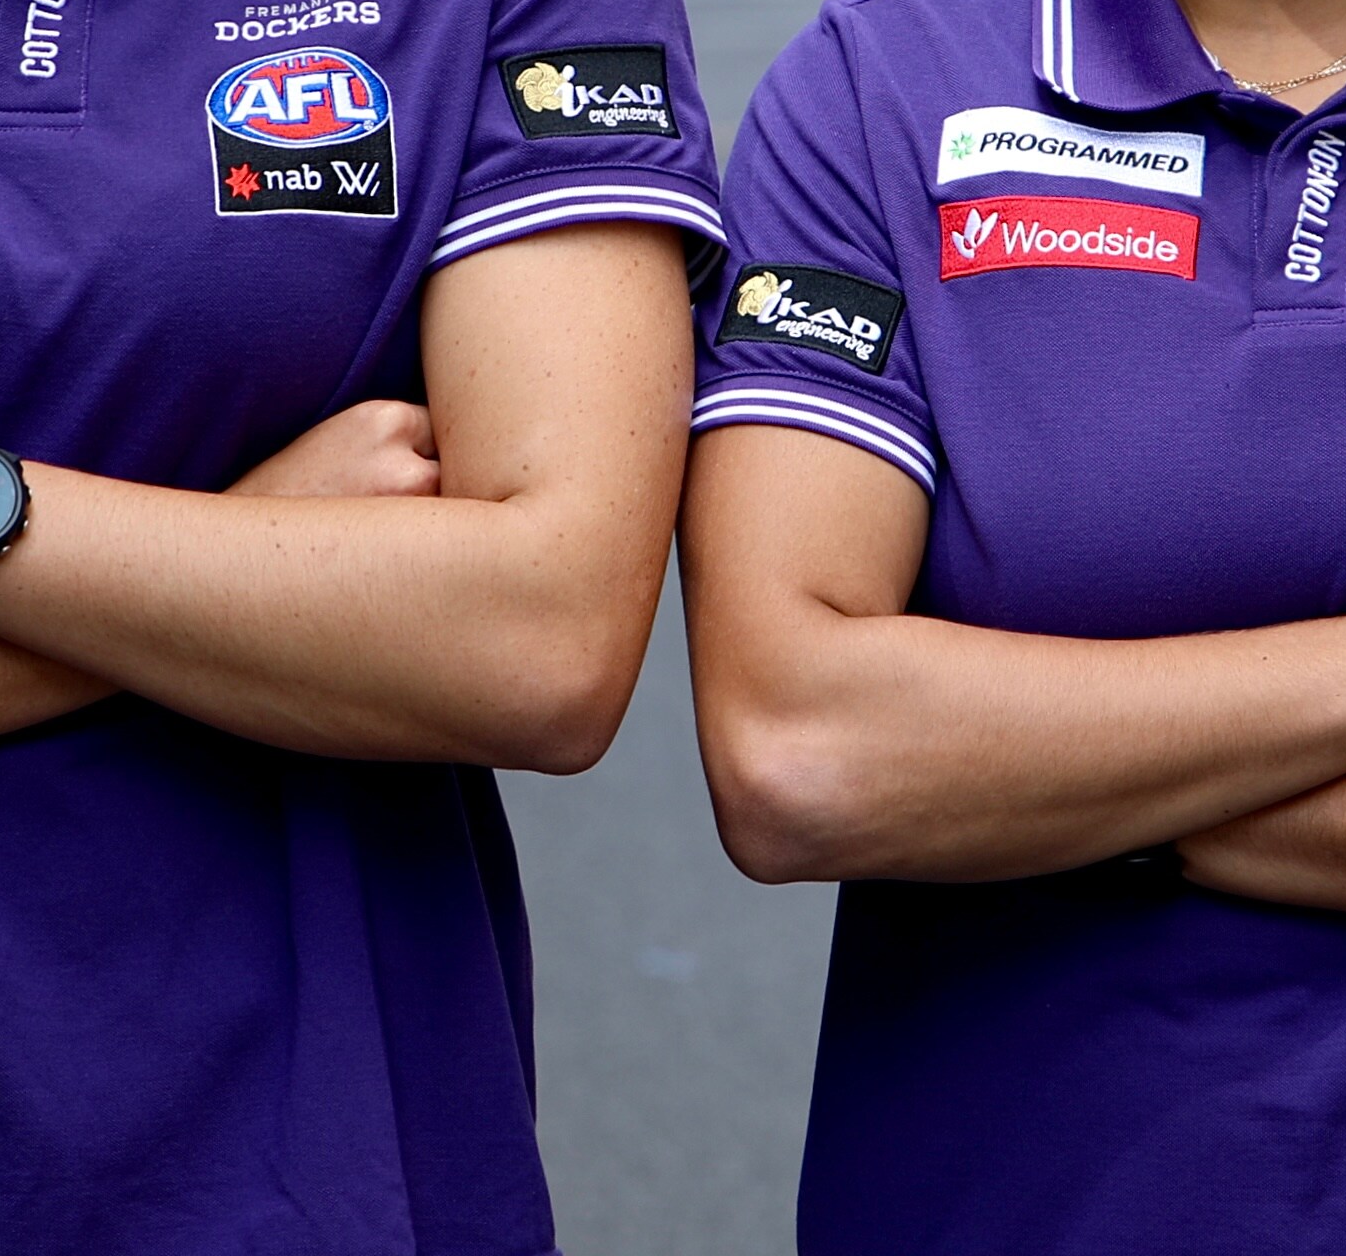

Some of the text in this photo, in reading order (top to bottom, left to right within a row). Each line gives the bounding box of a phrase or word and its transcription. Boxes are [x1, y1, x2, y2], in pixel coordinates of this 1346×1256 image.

[214, 1, 381, 42] DOCKERS
[226, 71, 378, 124] AFL
[588, 105, 668, 128] engineering
[979, 132, 1189, 173] PROGRAMMED
[263, 164, 323, 191] nab
[1284, 130, 1346, 283] COTTON:ON
[1002, 220, 1179, 262] Woodside
[775, 318, 875, 360] engineering
